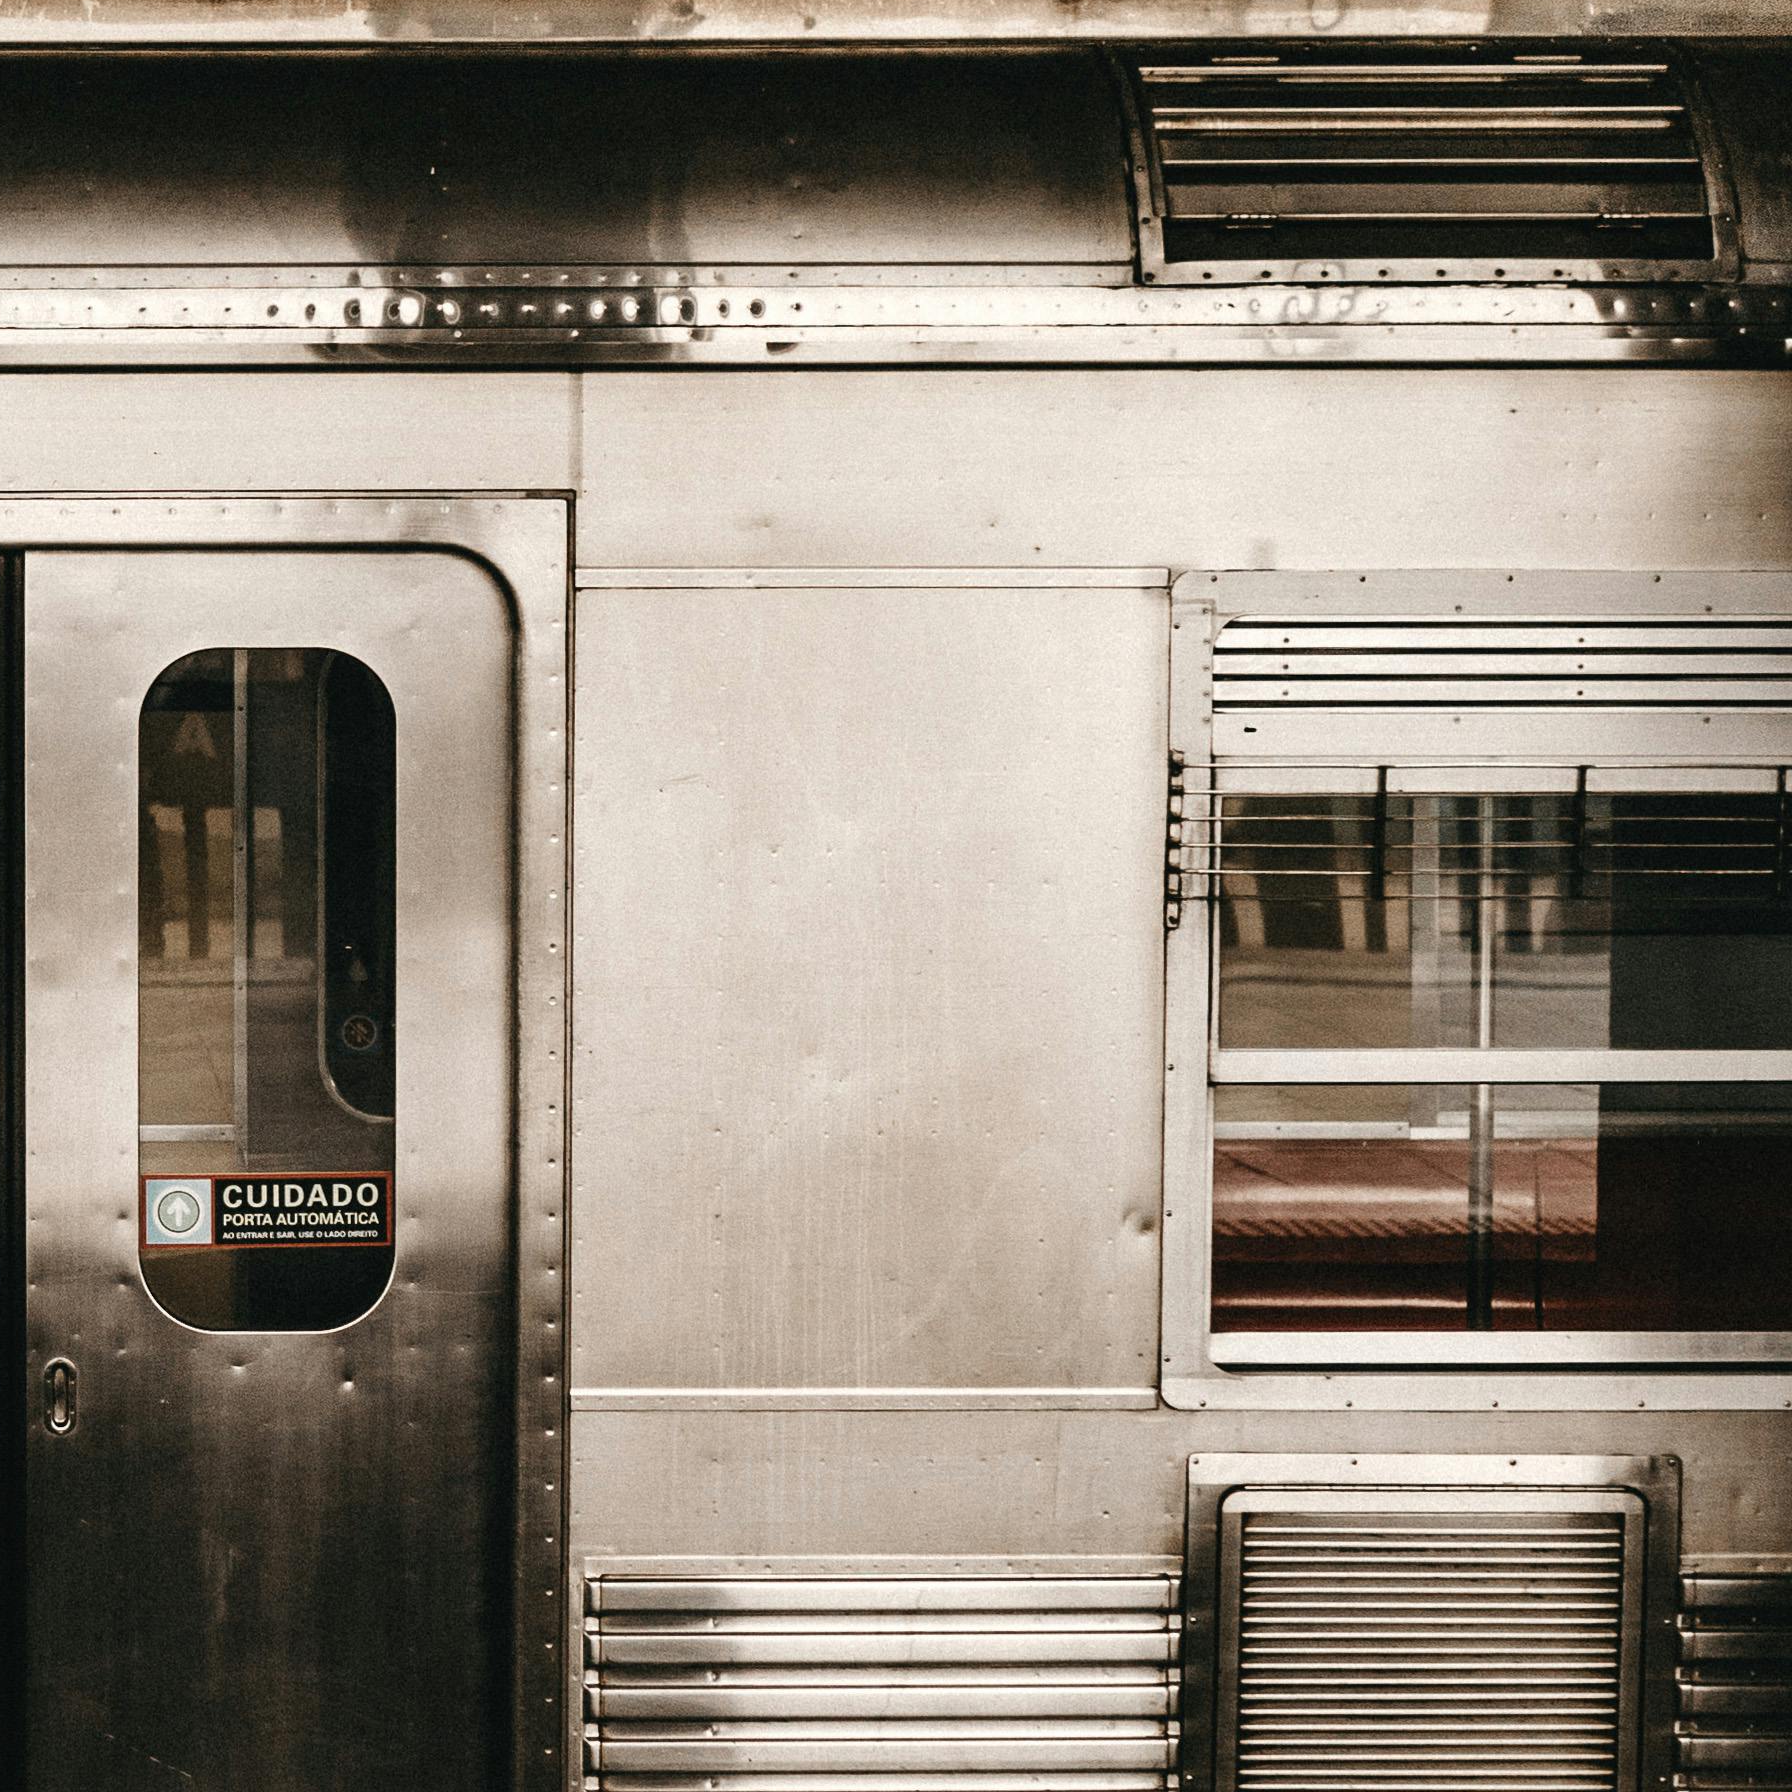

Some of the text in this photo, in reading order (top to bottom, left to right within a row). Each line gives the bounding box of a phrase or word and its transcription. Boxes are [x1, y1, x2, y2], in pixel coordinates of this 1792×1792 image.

[222, 1182, 379, 1208] CUIDADO
[223, 1209, 379, 1227] PORTA AUTOMÁTICA
[222, 1231, 235, 1240] AO
[236, 1231, 269, 1240] ENTRAR
[298, 1230, 315, 1239] USE
[316, 1230, 323, 1239] O
[324, 1230, 346, 1239] LADO
[347, 1229, 379, 1238] DIREITO
